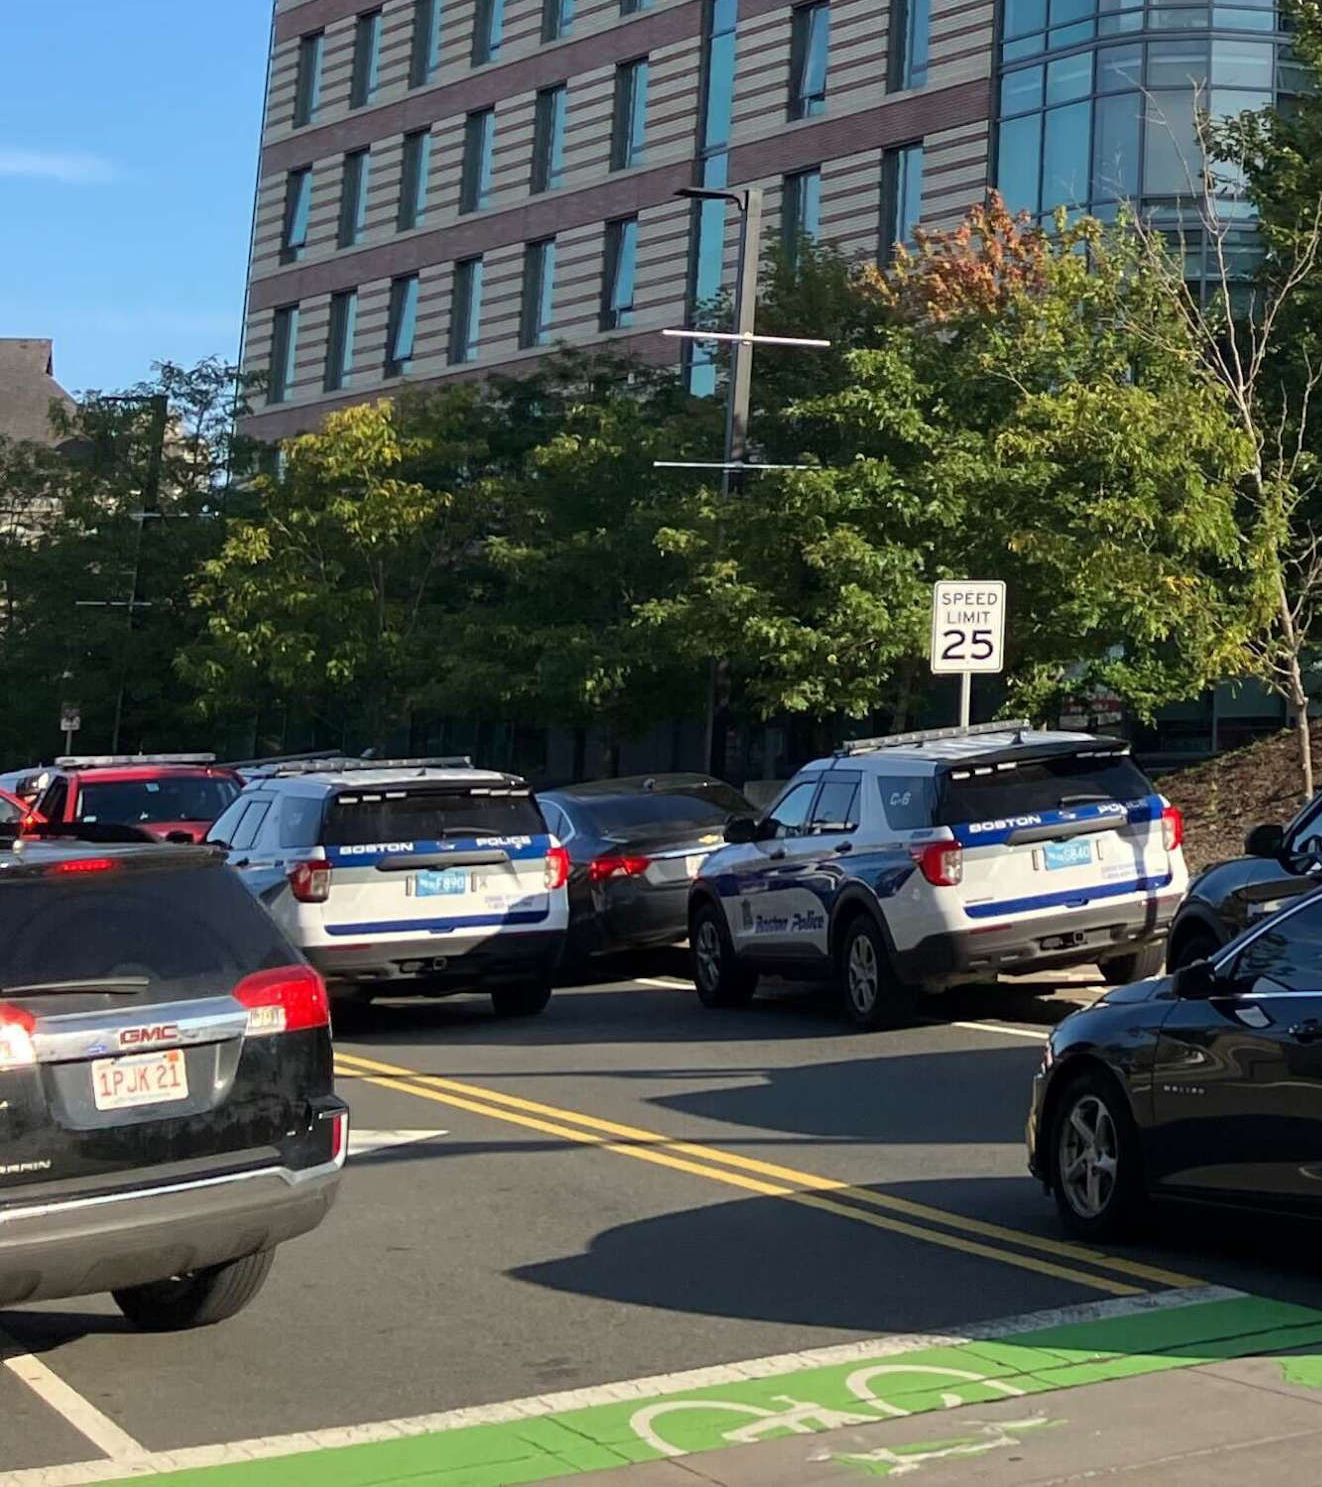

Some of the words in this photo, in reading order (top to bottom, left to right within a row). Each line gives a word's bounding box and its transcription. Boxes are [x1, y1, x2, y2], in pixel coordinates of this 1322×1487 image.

[942, 592, 998, 606] SPEED
[947, 611, 991, 625] LIMIT
[940, 629, 994, 660] 25
[889, 792, 912, 807] C-6
[968, 814, 1042, 834] BOSTON
[1098, 798, 1147, 813] POLICE
[339, 841, 414, 855] BOSTON
[476, 835, 531, 848] POLICE
[789, 910, 825, 932] Police
[119, 1024, 179, 1045] GMC
[156, 1064, 181, 1089] 21
